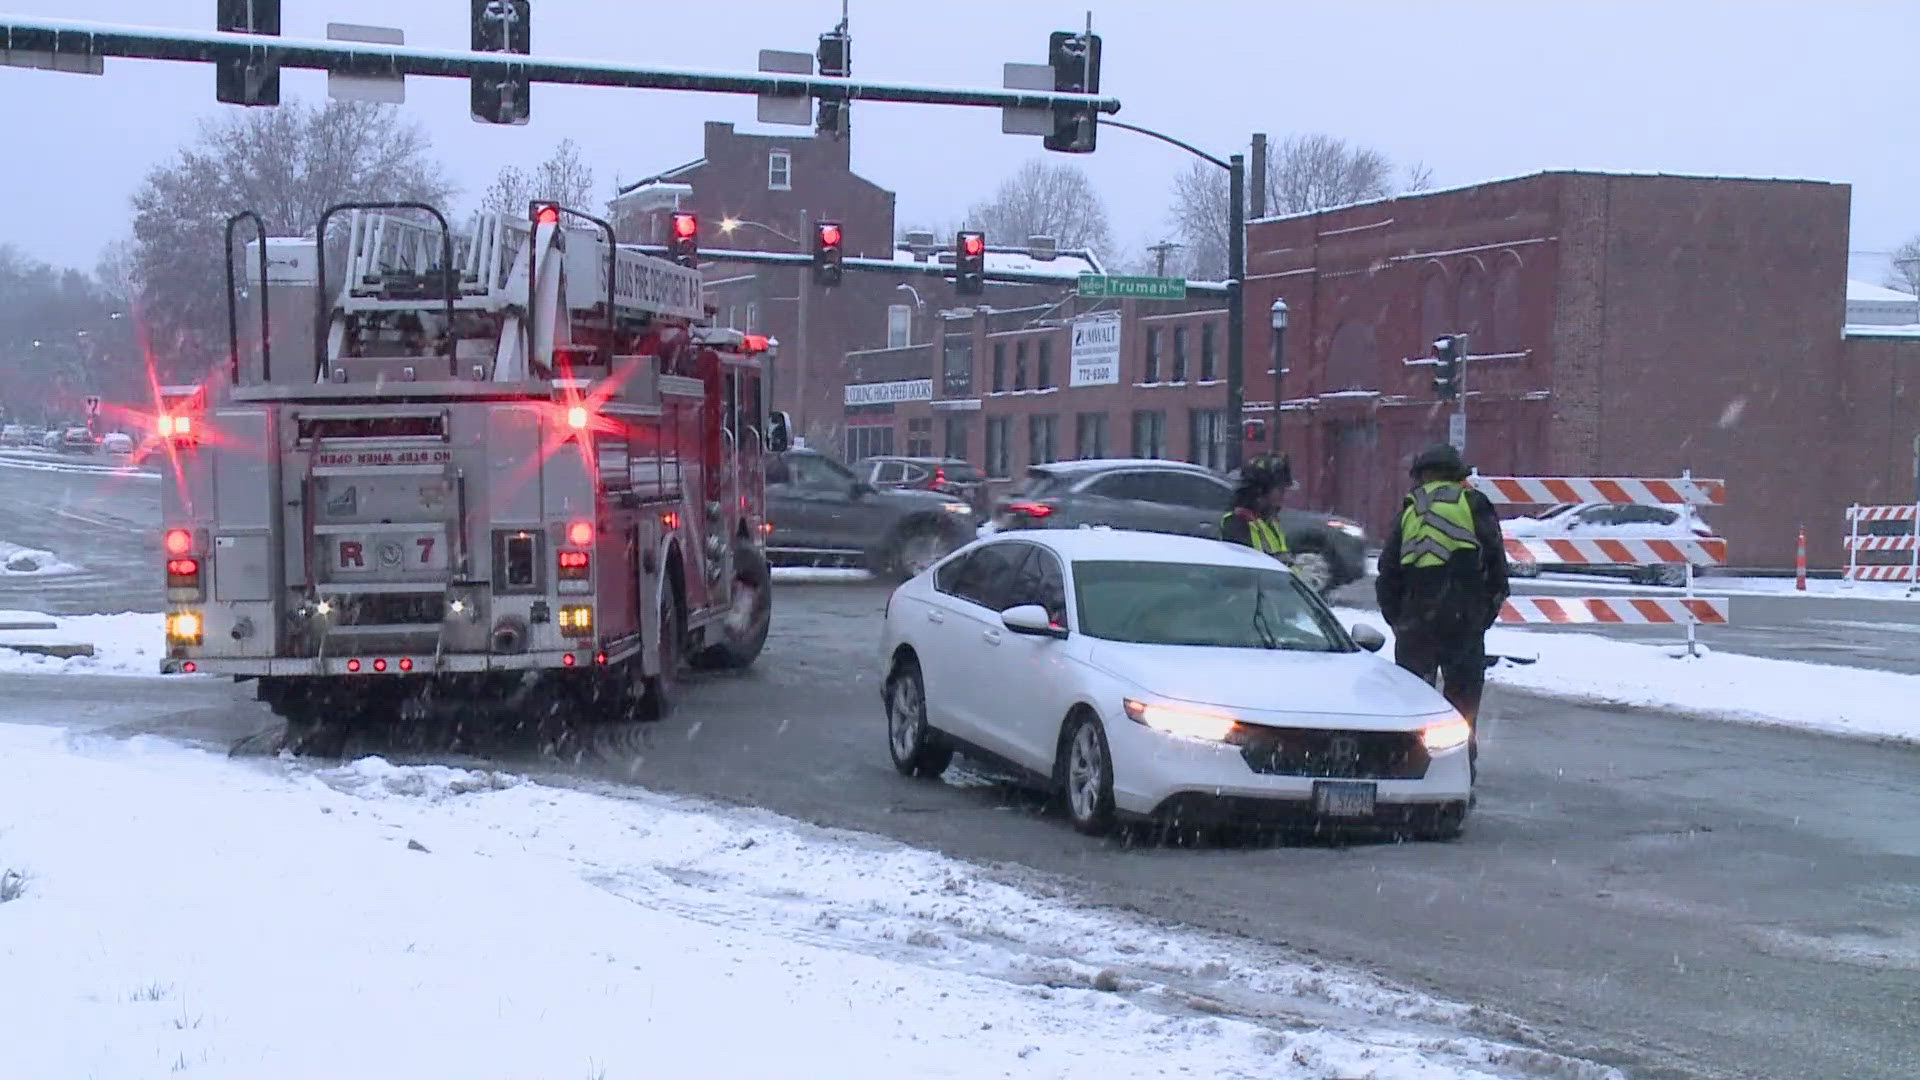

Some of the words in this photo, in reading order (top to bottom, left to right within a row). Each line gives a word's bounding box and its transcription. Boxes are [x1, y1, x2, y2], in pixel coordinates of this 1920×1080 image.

[635, 264, 649, 301] FIRE
[1111, 279, 1168, 294] Truman
[1075, 326, 1116, 347] ZUMWALT
[874, 385, 889, 401] HIGH
[890, 383, 908, 400] SPEED
[909, 381, 931, 398] DOORS
[319, 454, 352, 464] OPEN
[357, 452, 393, 463] WHEN
[397, 451, 428, 462] STEP
[434, 450, 451, 461] NO
[339, 541, 364, 567] R
[416, 538, 435, 563] 7
